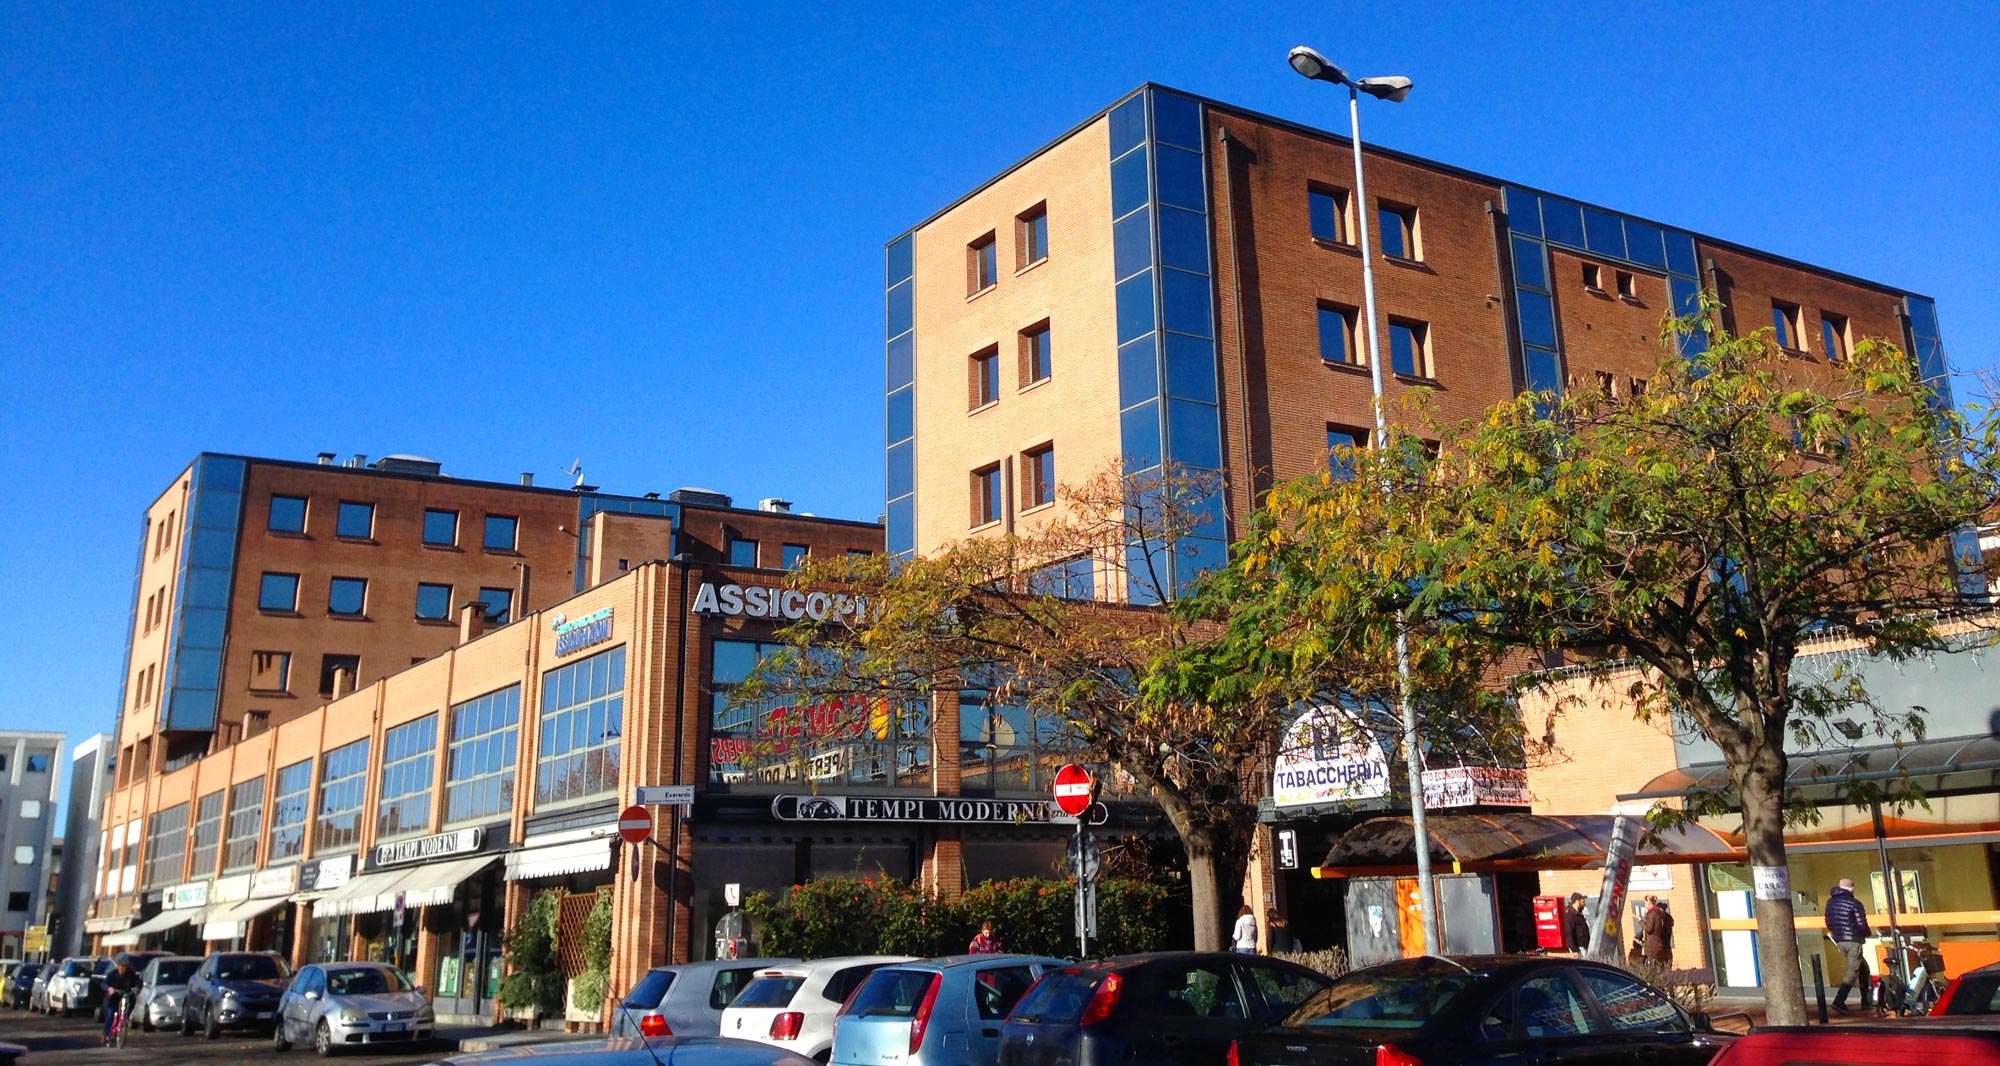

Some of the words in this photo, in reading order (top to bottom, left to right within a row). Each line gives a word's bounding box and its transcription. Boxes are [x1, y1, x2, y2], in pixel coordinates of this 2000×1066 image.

[1278, 762, 1384, 789] TABACCHERIA
[852, 799, 924, 819] TEMPI
[939, 801, 1046, 821] MODERNI
[395, 840, 418, 860] TEMPI
[420, 833, 458, 856] MODERNI
